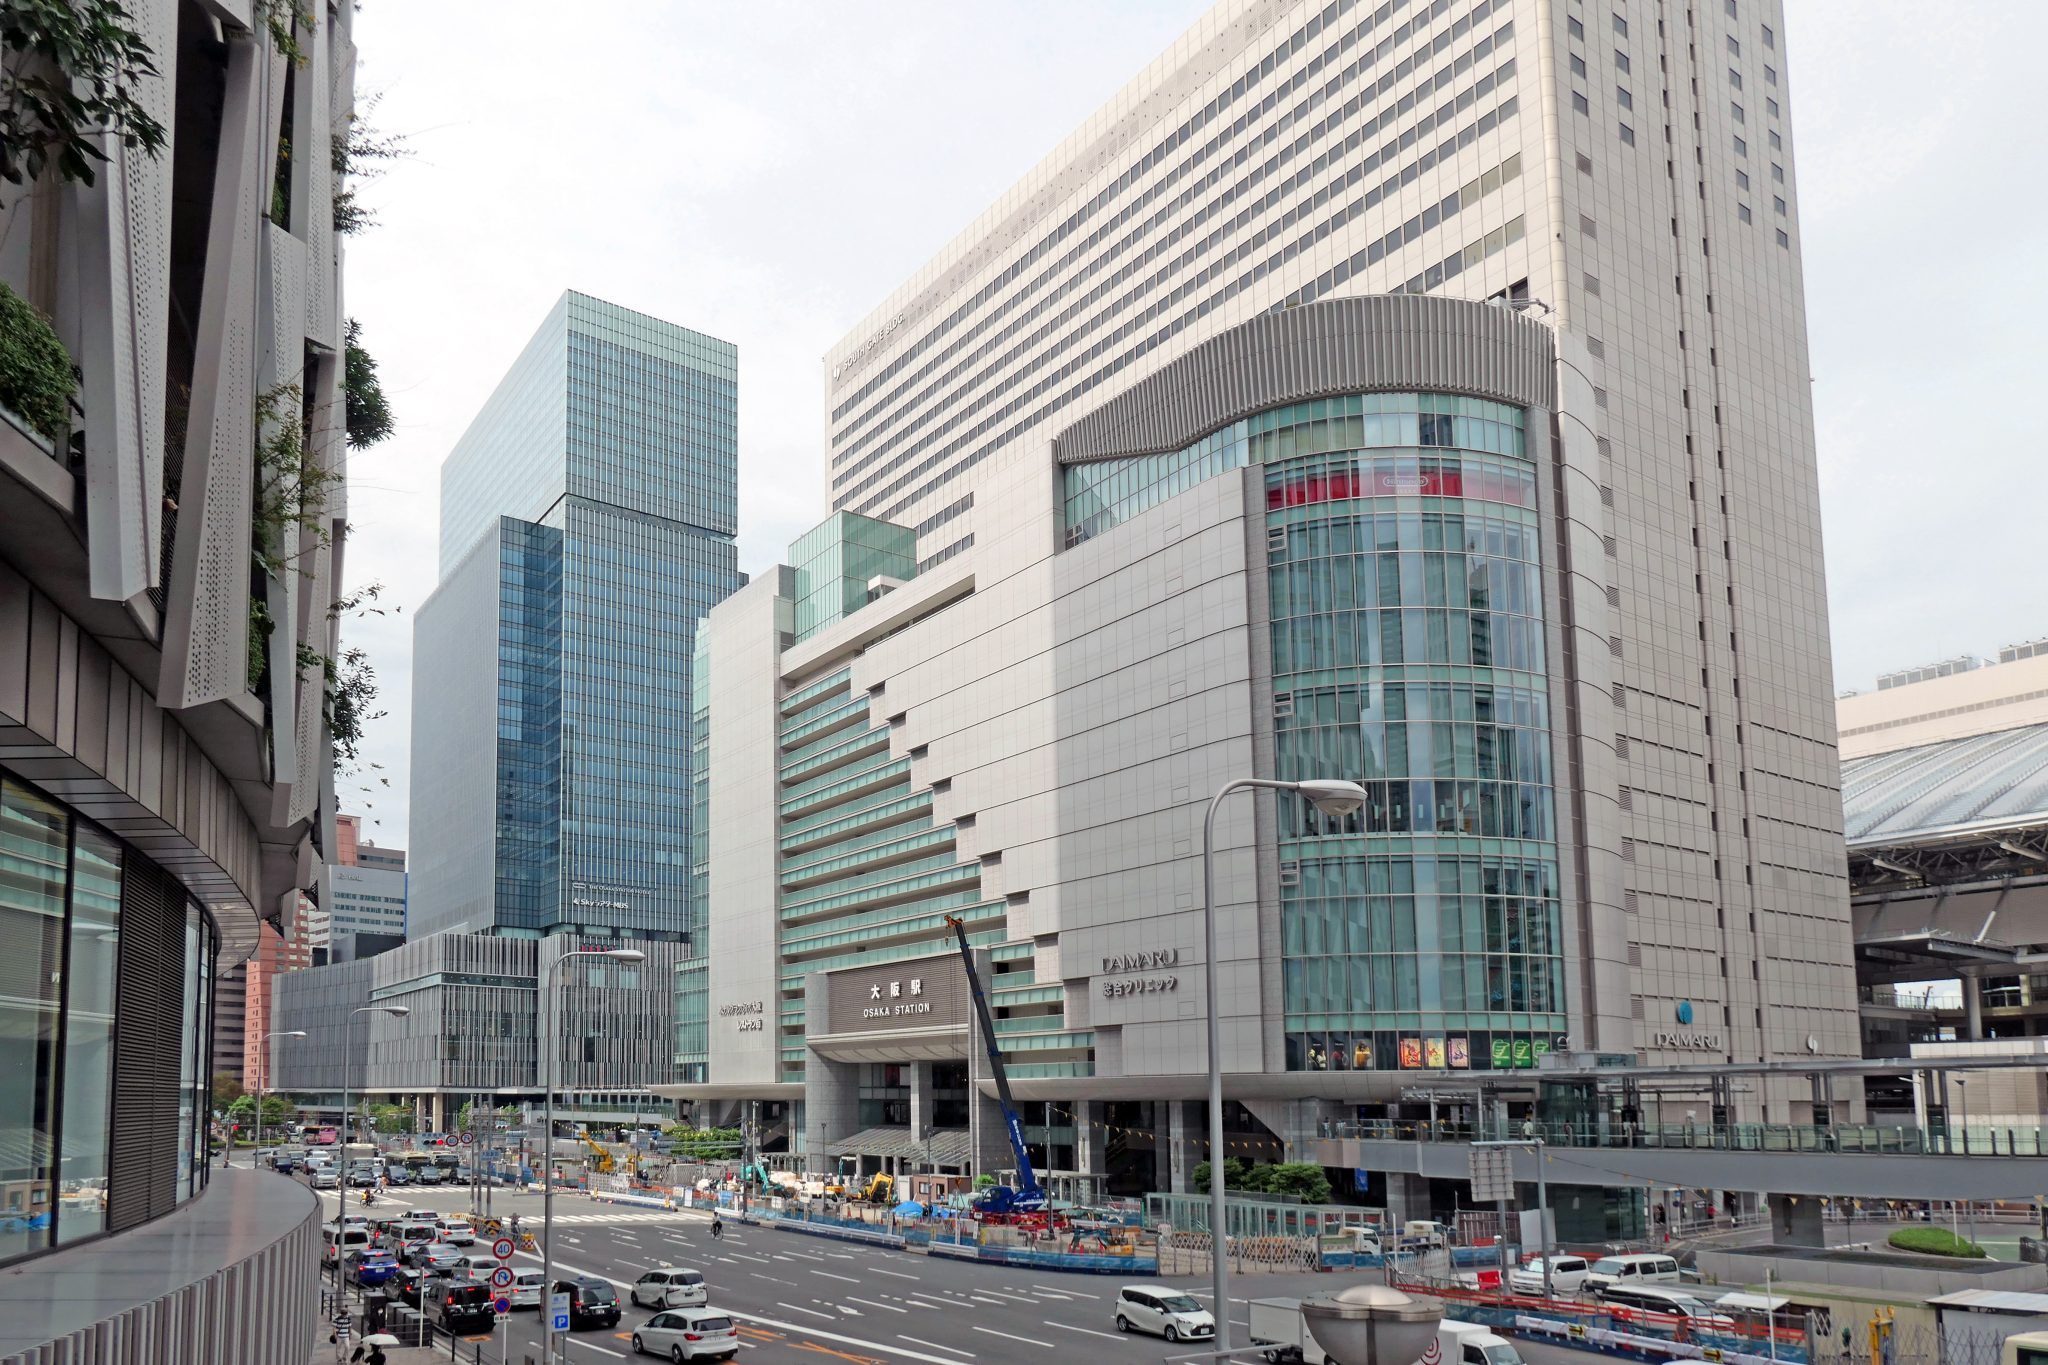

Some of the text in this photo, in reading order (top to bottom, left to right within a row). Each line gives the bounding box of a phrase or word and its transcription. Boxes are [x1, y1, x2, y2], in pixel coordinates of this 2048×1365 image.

[844, 345, 866, 371] SOUTH
[866, 329, 885, 352] GATE
[1101, 948, 1178, 972] DAIMARU
[870, 979, 921, 999] 大阪駅
[1103, 976, 1177, 997] 総合クリニック
[863, 1003, 930, 1018] OSAKA STATION
[1656, 1032, 1720, 1048] DAIMARU
[497, 1244, 510, 1254] 40
[558, 1317, 567, 1328] P
